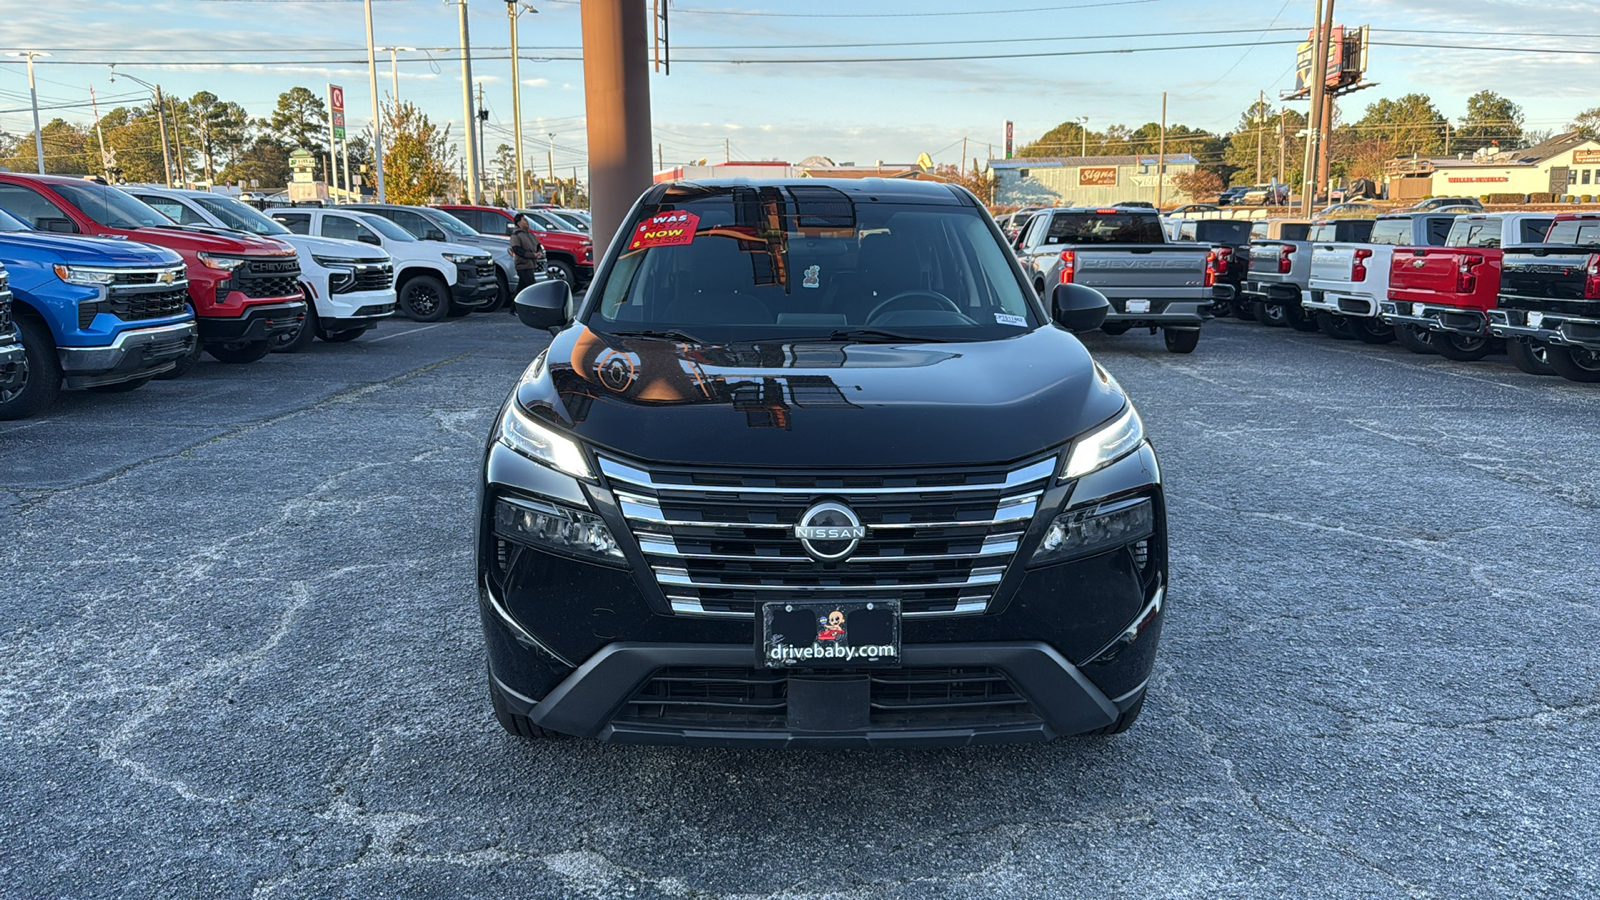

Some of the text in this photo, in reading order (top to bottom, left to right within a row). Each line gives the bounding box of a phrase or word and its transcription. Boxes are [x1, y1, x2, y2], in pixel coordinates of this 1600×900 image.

[1081, 169, 1115, 182] Signs
[653, 214, 688, 224] WAS
[644, 229, 684, 239] NOW
[251, 261, 299, 271] CHEVROLE
[1083, 260, 1198, 269] CHEVROLET
[797, 528, 864, 538] NISSAN
[771, 643, 895, 661] drivebaby.com
